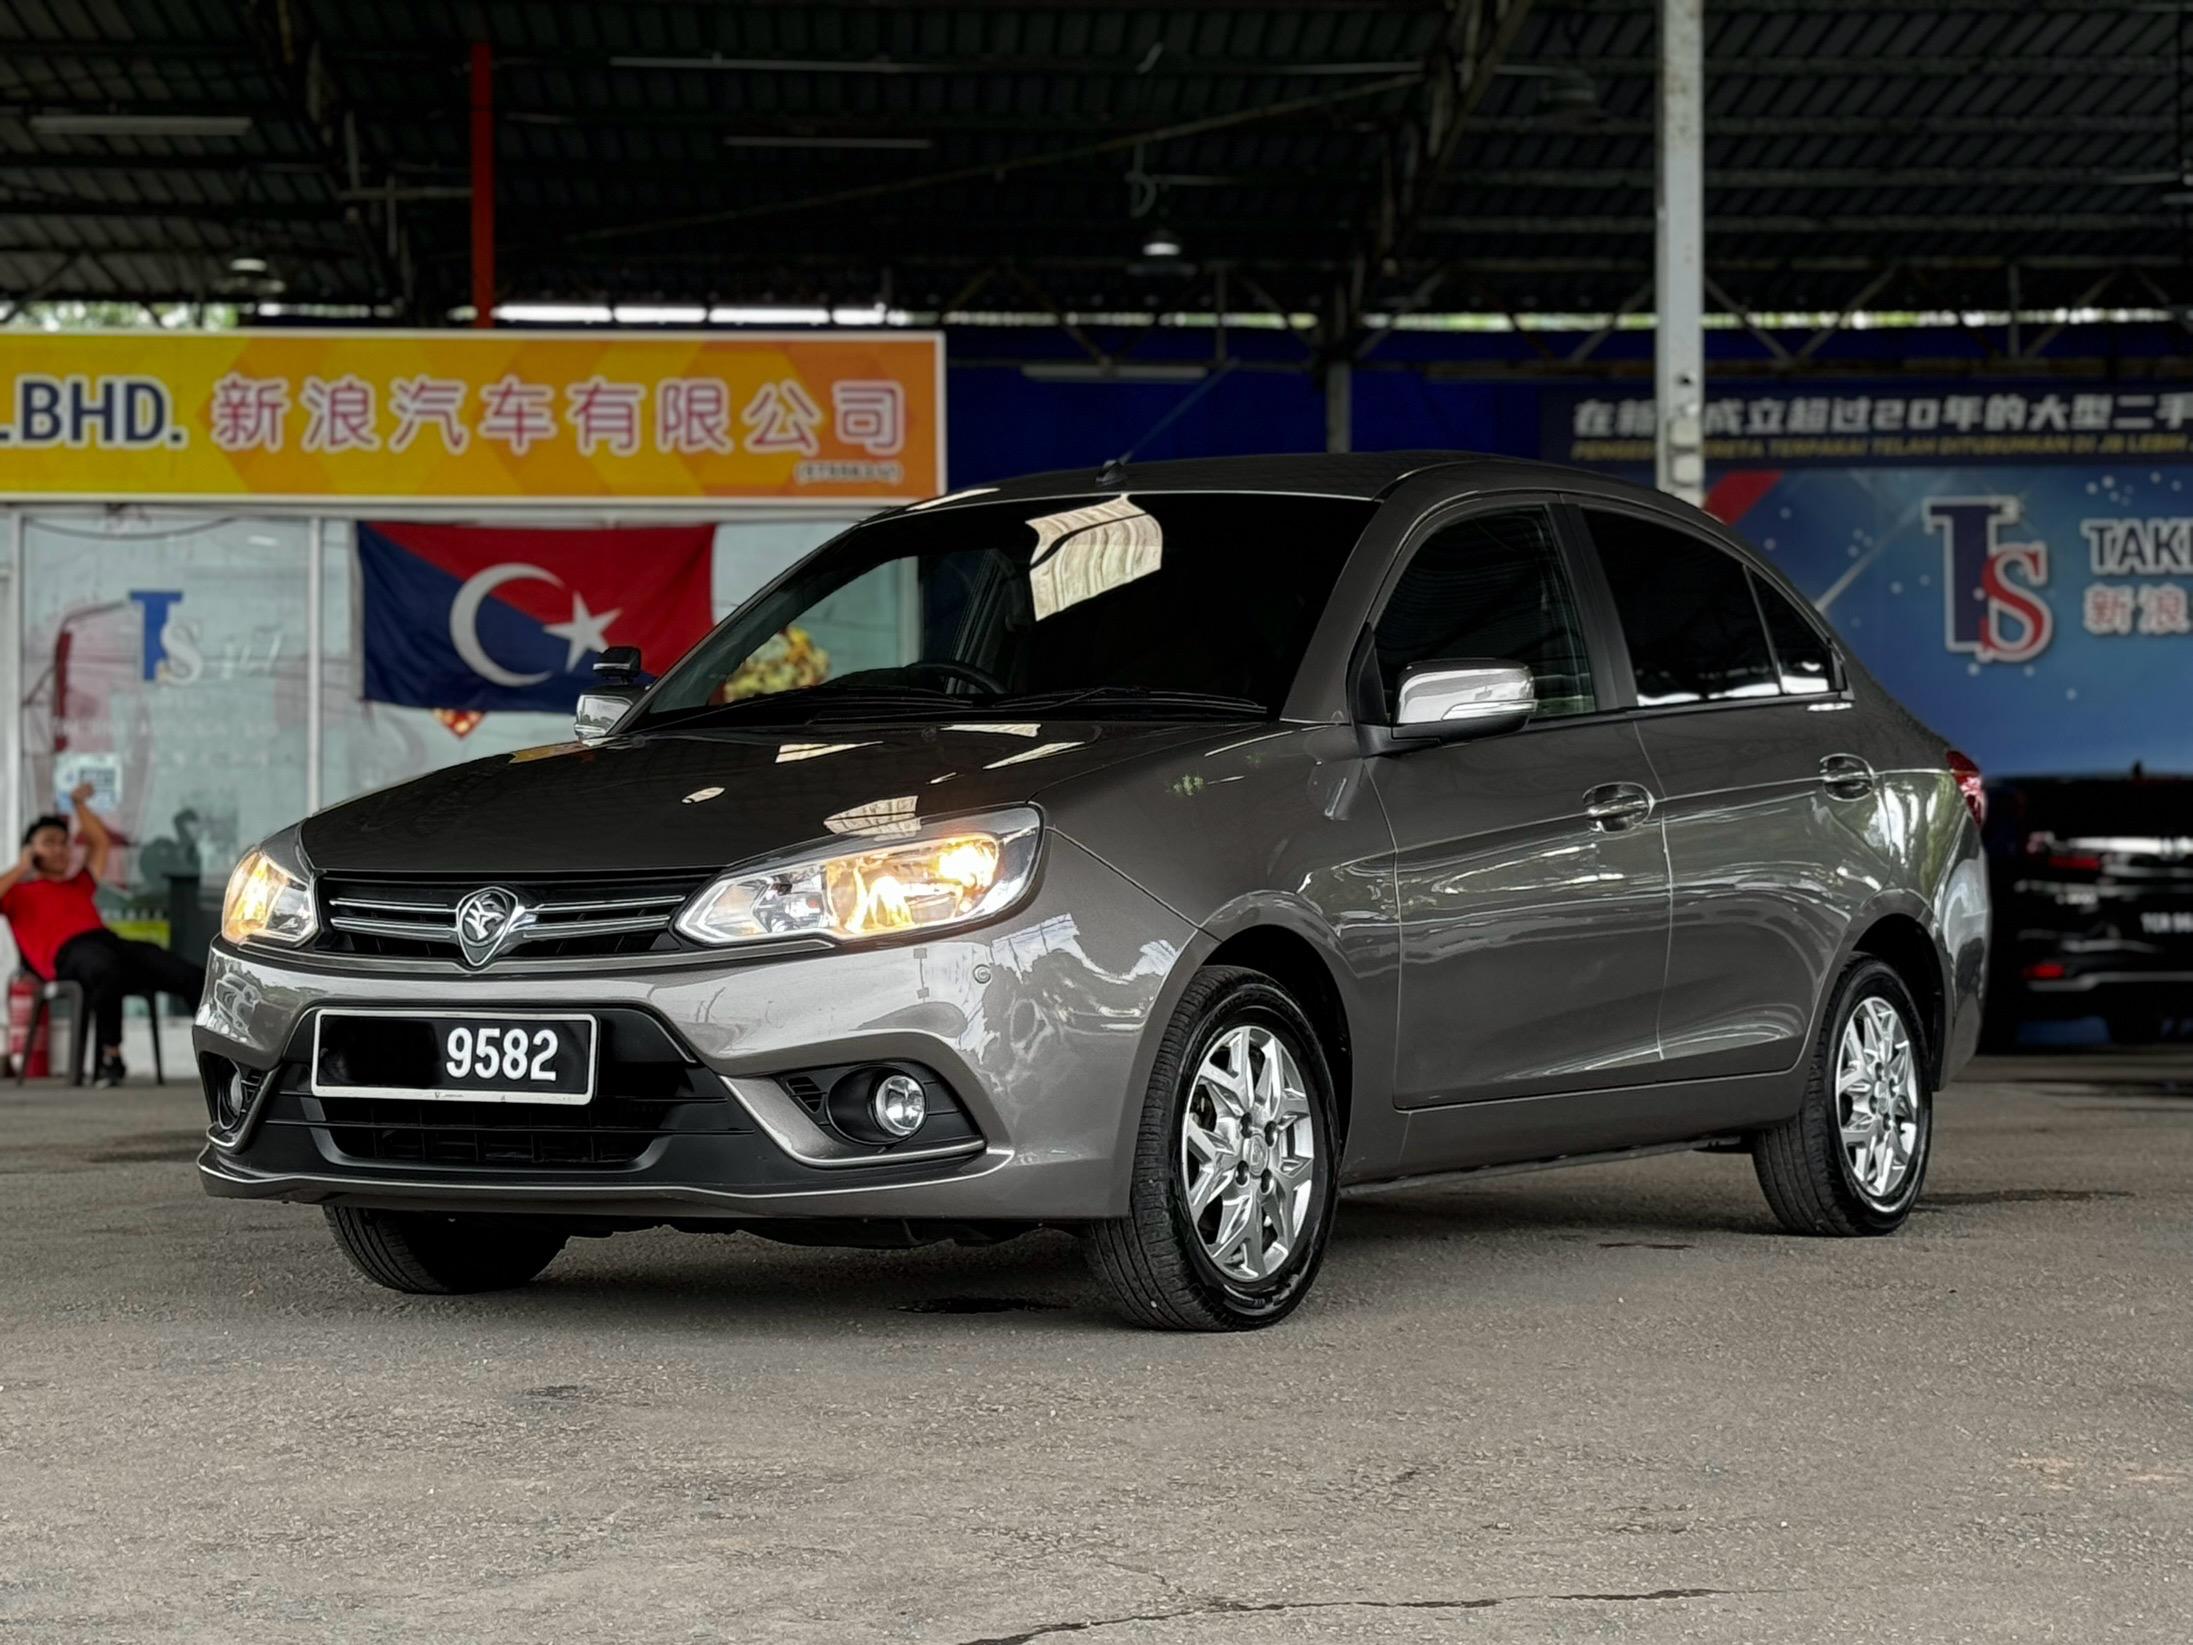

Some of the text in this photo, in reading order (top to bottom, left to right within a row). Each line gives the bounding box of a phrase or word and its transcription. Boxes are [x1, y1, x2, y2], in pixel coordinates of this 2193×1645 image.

[214, 376, 904, 453] 新浪汽车有限公司
[2083, 521, 2193, 572] TAK
[446, 1027, 559, 1081] 9582
